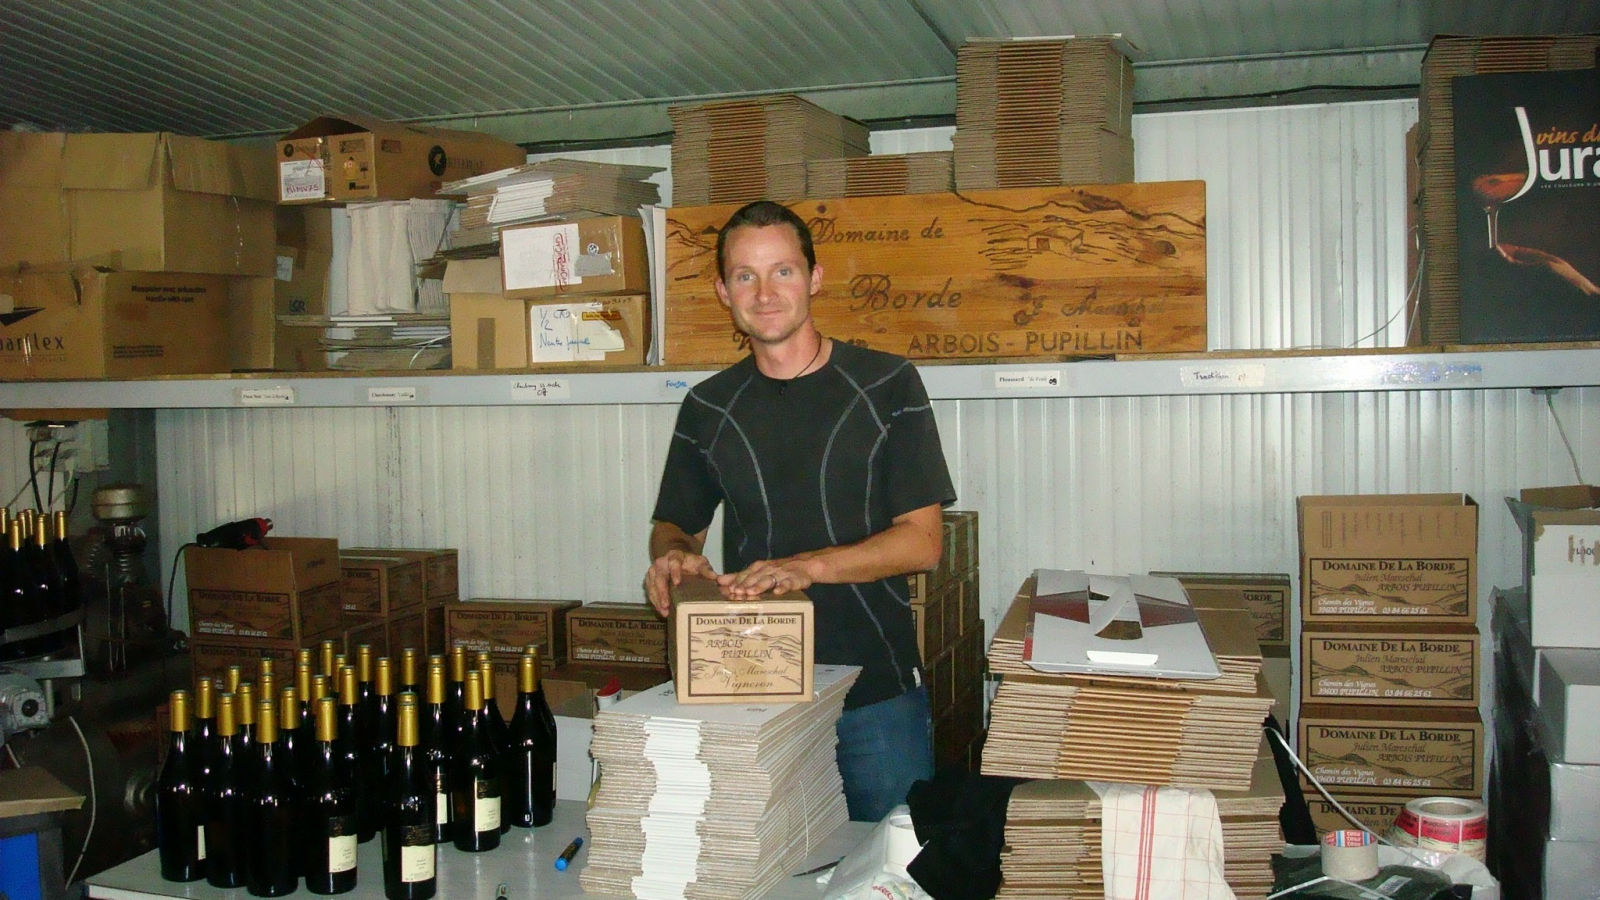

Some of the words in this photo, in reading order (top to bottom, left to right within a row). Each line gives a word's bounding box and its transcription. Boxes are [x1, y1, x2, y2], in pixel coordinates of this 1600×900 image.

[1536, 127, 1579, 145] vins
[808, 216, 911, 245] Domaine
[921, 217, 943, 240] de
[849, 273, 963, 314] Borde
[907, 333, 999, 354] ARBOIS
[1026, 331, 1143, 352] PUPILLIN
[1322, 560, 1376, 571] DOMAINE
[1378, 561, 1395, 571] DE
[1398, 561, 1413, 571] LA
[1416, 561, 1456, 572] BORDE
[1377, 583, 1410, 591] ARBOIS
[1412, 583, 1458, 591] PUPILLIN
[1317, 598, 1342, 606] Chemin
[1343, 597, 1352, 606] des
[1353, 598, 1374, 607] Vignes
[1338, 606, 1377, 614] PUPILLIN
[456, 612, 489, 620] DOMAINE
[514, 613, 539, 621] BORDE
[696, 617, 738, 625] DOMAINE
[739, 617, 752, 625] DE
[754, 617, 765, 625] LA
[767, 617, 796, 625] BORDE
[579, 619, 614, 628] DOMAINE
[616, 620, 627, 629] DE
[629, 621, 639, 629] LA
[706, 639, 743, 649] ARBOIS
[1323, 640, 1378, 651] DOMAINE
[1381, 641, 1398, 652] DE
[1400, 642, 1416, 652] LA
[1419, 642, 1460, 653] BORDE
[721, 649, 774, 659] PUPILLIN
[1354, 654, 1380, 663] Julien
[742, 665, 788, 676] Mareschal
[1379, 665, 1413, 673] ARBOIS
[1416, 665, 1462, 674] PUPILLIN
[720, 676, 773, 691] Vigneron
[1318, 679, 1342, 687] Chemin
[1343, 679, 1354, 687] des
[1355, 680, 1376, 689] Vignes
[1339, 688, 1379, 696] PUPILLIN
[1320, 728, 1376, 739] DOMAINE
[1379, 729, 1396, 740] DE
[1400, 730, 1415, 740] LA
[1418, 730, 1461, 742] BORDE
[1353, 743, 1379, 752] Julien
[1377, 754, 1412, 762] ARBOIS
[1414, 754, 1462, 764] PUPILLIN
[1315, 767, 1340, 775] Chemin
[1341, 767, 1351, 775] des
[1352, 768, 1374, 778] Vignes
[1337, 776, 1377, 785] PUPILLIN
[1379, 806, 1397, 815] DE
